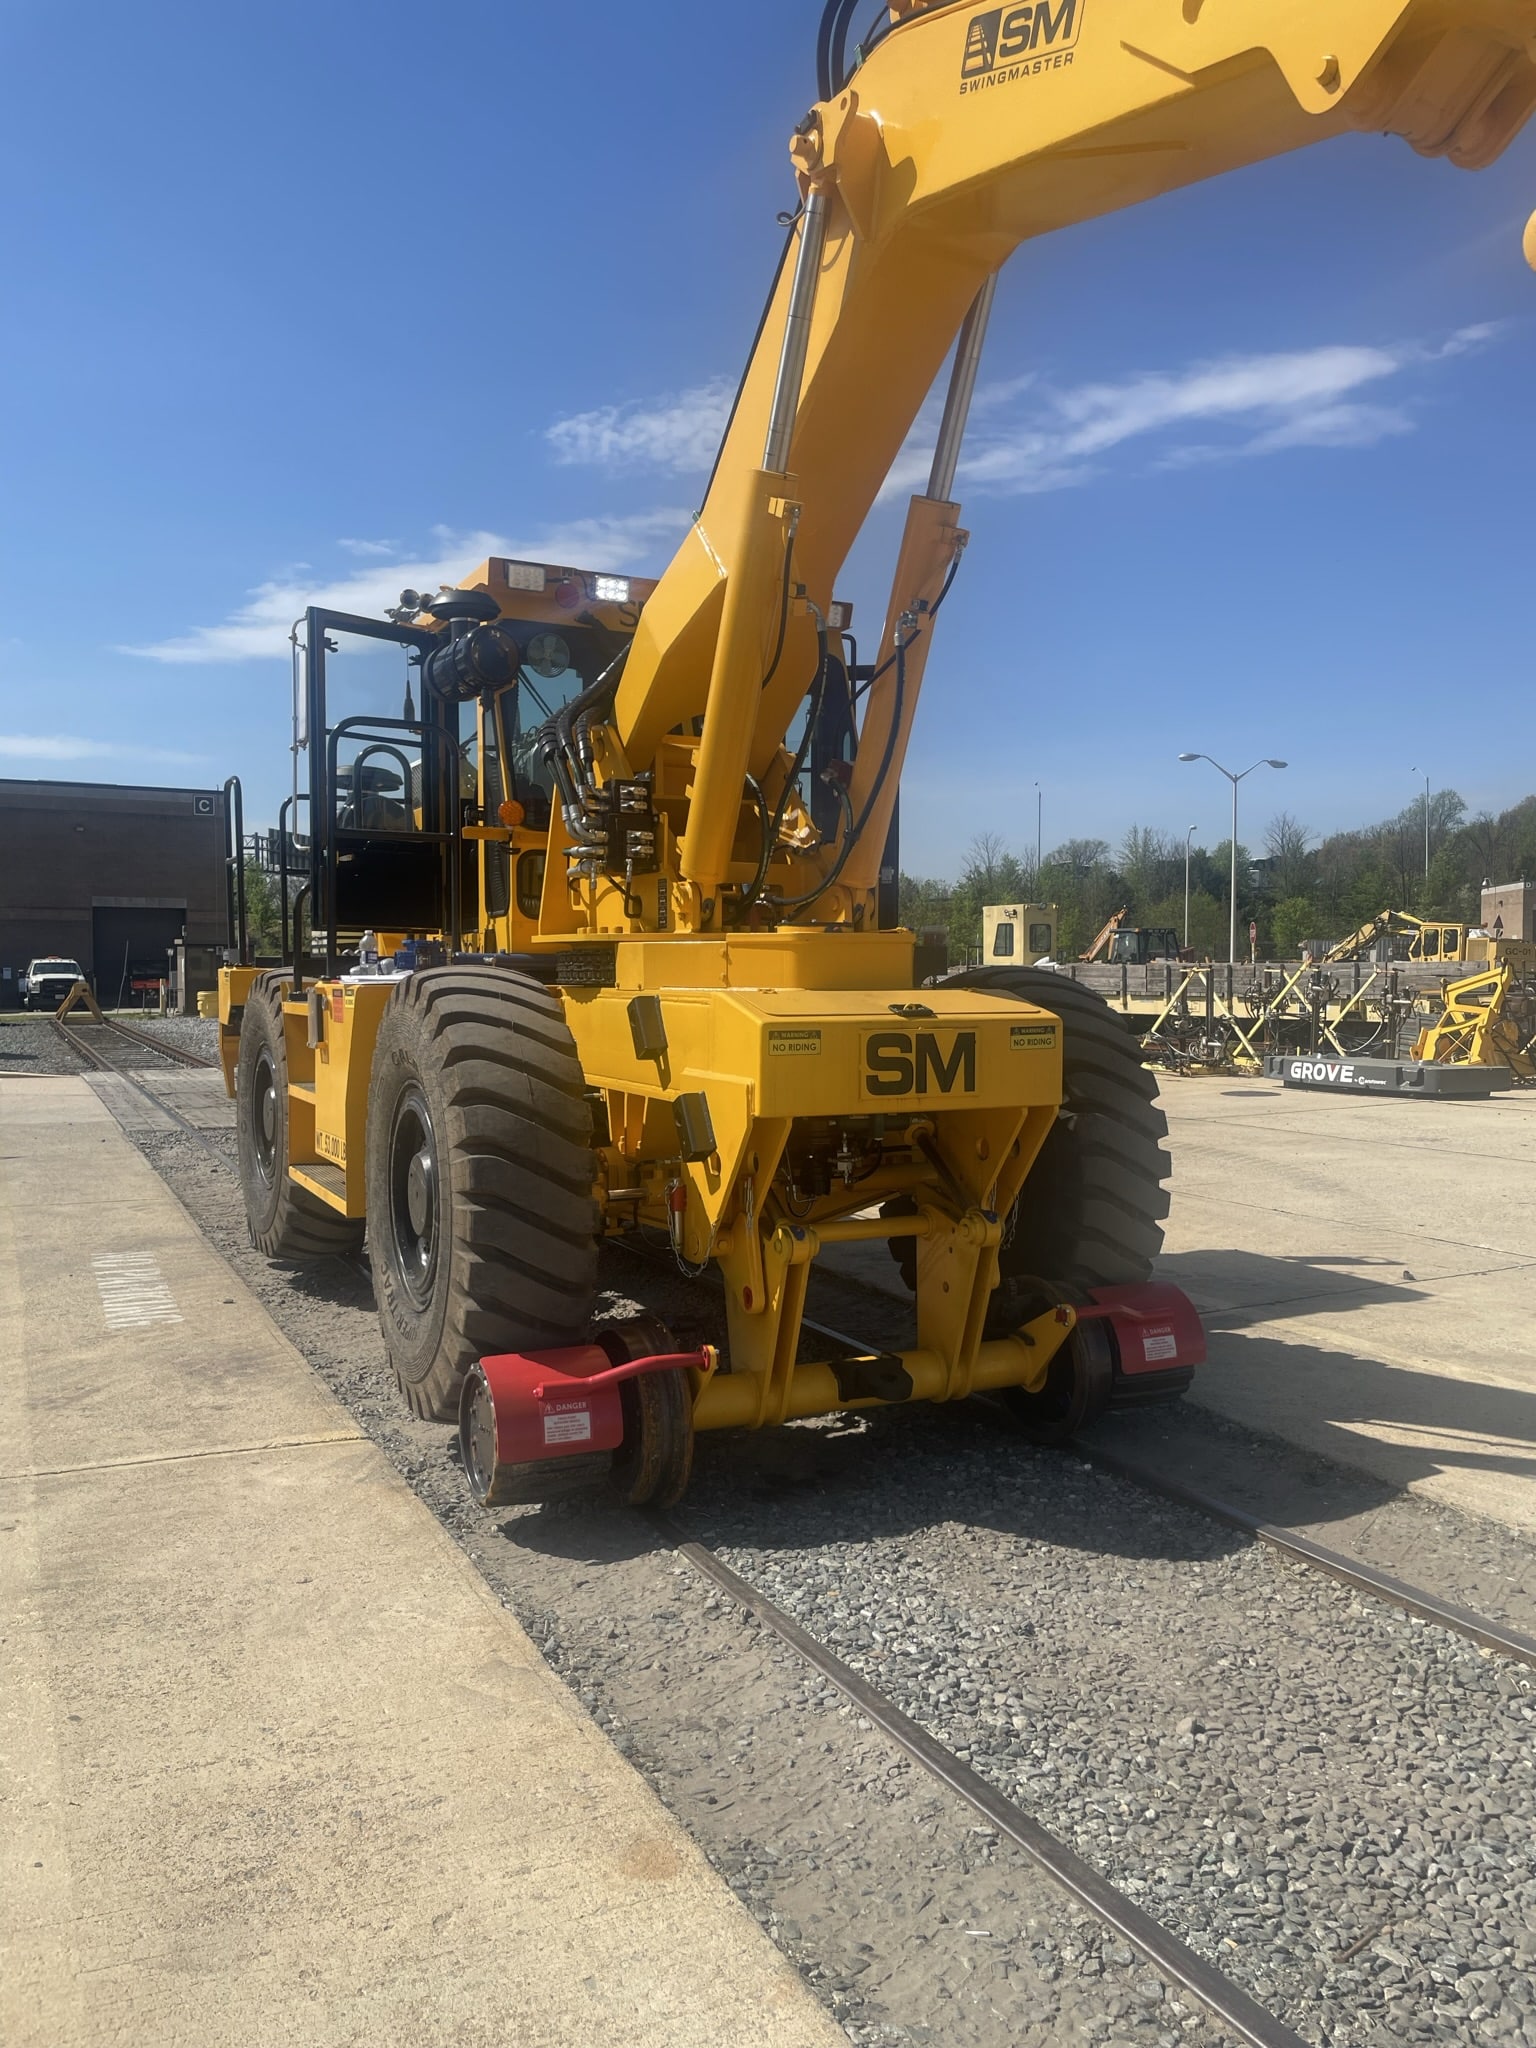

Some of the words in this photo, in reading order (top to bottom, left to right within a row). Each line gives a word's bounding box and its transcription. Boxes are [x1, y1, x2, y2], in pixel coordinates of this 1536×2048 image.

[999, 0, 1077, 58] SM
[959, 52, 1074, 95] SWINGMASTER
[199, 799, 210, 812] C
[1505, 947, 1531, 956] GC-01
[772, 1043, 786, 1052] NO
[788, 1042, 817, 1052] RIDING
[1013, 1038, 1026, 1047] NO
[1027, 1037, 1052, 1046] RIDING
[865, 1031, 977, 1096] SM
[1290, 1061, 1355, 1083] GROVE
[555, 1401, 587, 1412] DANGER
